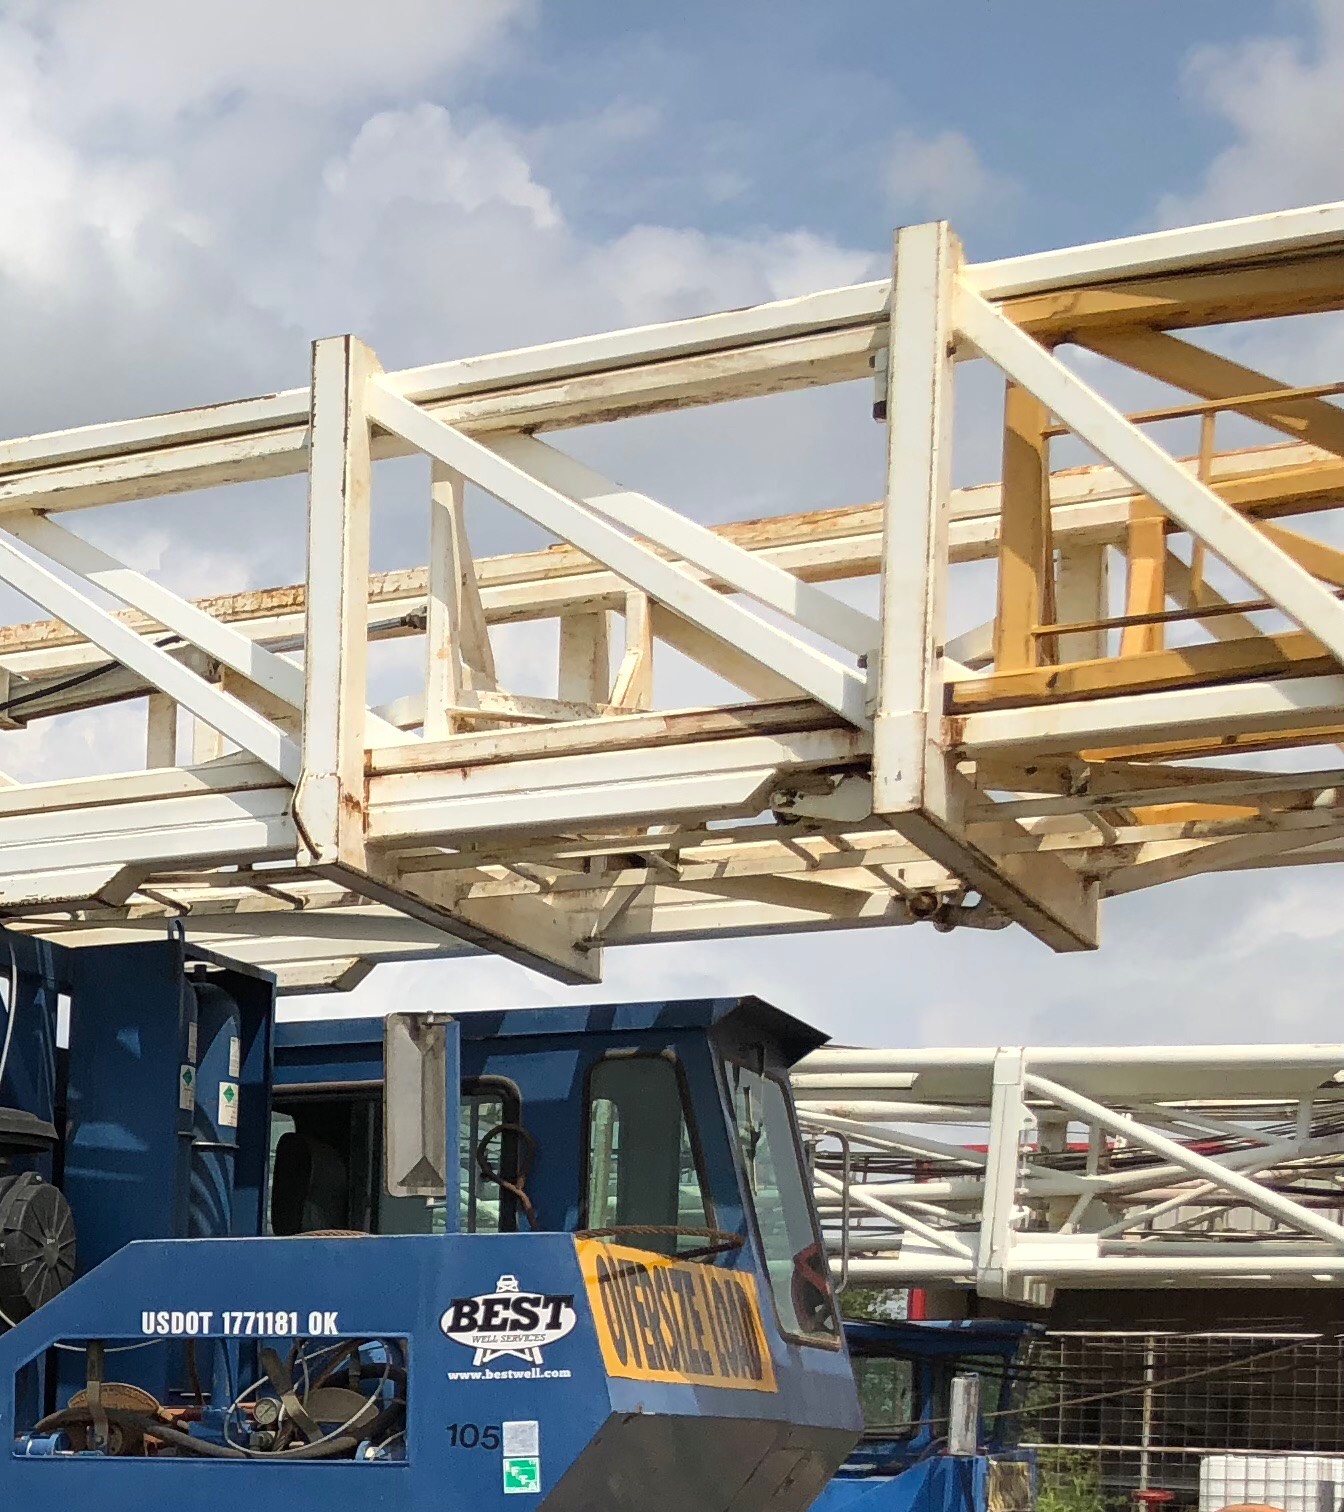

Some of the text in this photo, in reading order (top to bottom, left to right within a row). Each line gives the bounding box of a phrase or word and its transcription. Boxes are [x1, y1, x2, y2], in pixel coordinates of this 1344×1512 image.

[141, 1311, 339, 1336] USDOT 1771181 OK
[446, 1294, 575, 1334] BEST
[595, 1253, 714, 1376] OVERSIZE
[472, 1333, 547, 1344] WELL SERVICES
[447, 1367, 572, 1381] www.bestwell.com
[446, 1422, 501, 1451] 105
